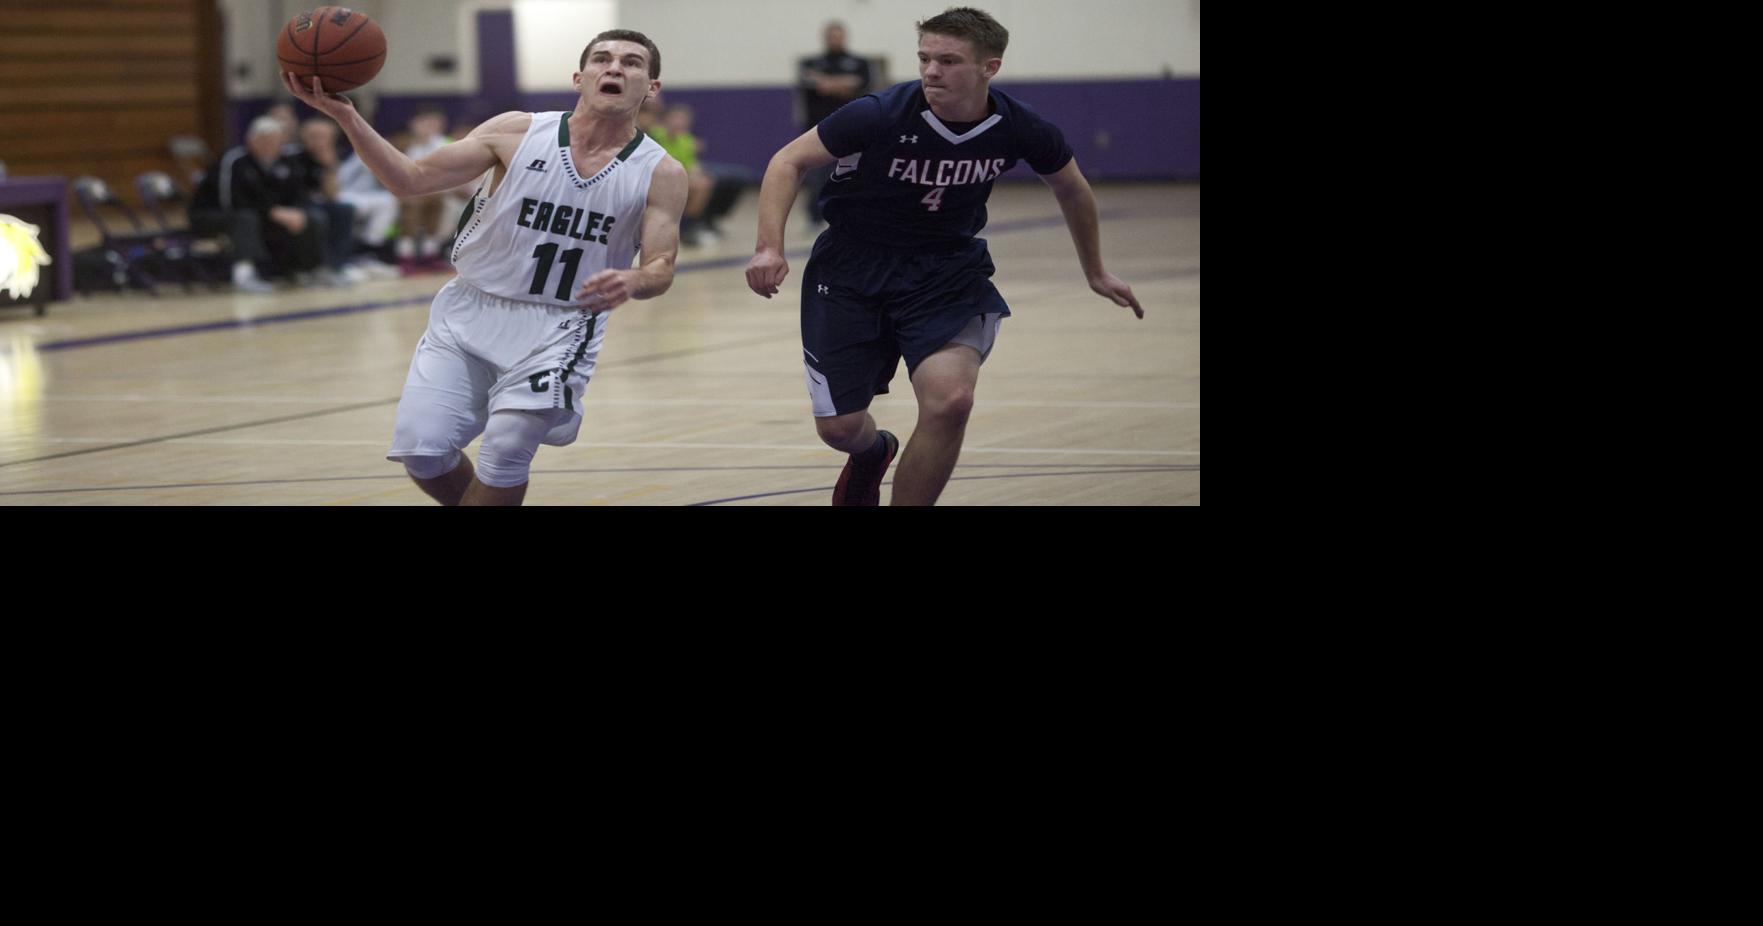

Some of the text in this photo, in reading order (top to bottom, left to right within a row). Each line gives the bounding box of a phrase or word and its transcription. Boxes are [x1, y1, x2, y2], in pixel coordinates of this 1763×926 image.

[888, 158, 1006, 186] FALCONS
[921, 187, 946, 211] 4
[516, 197, 616, 246] EAGLES
[528, 242, 585, 302] 11
